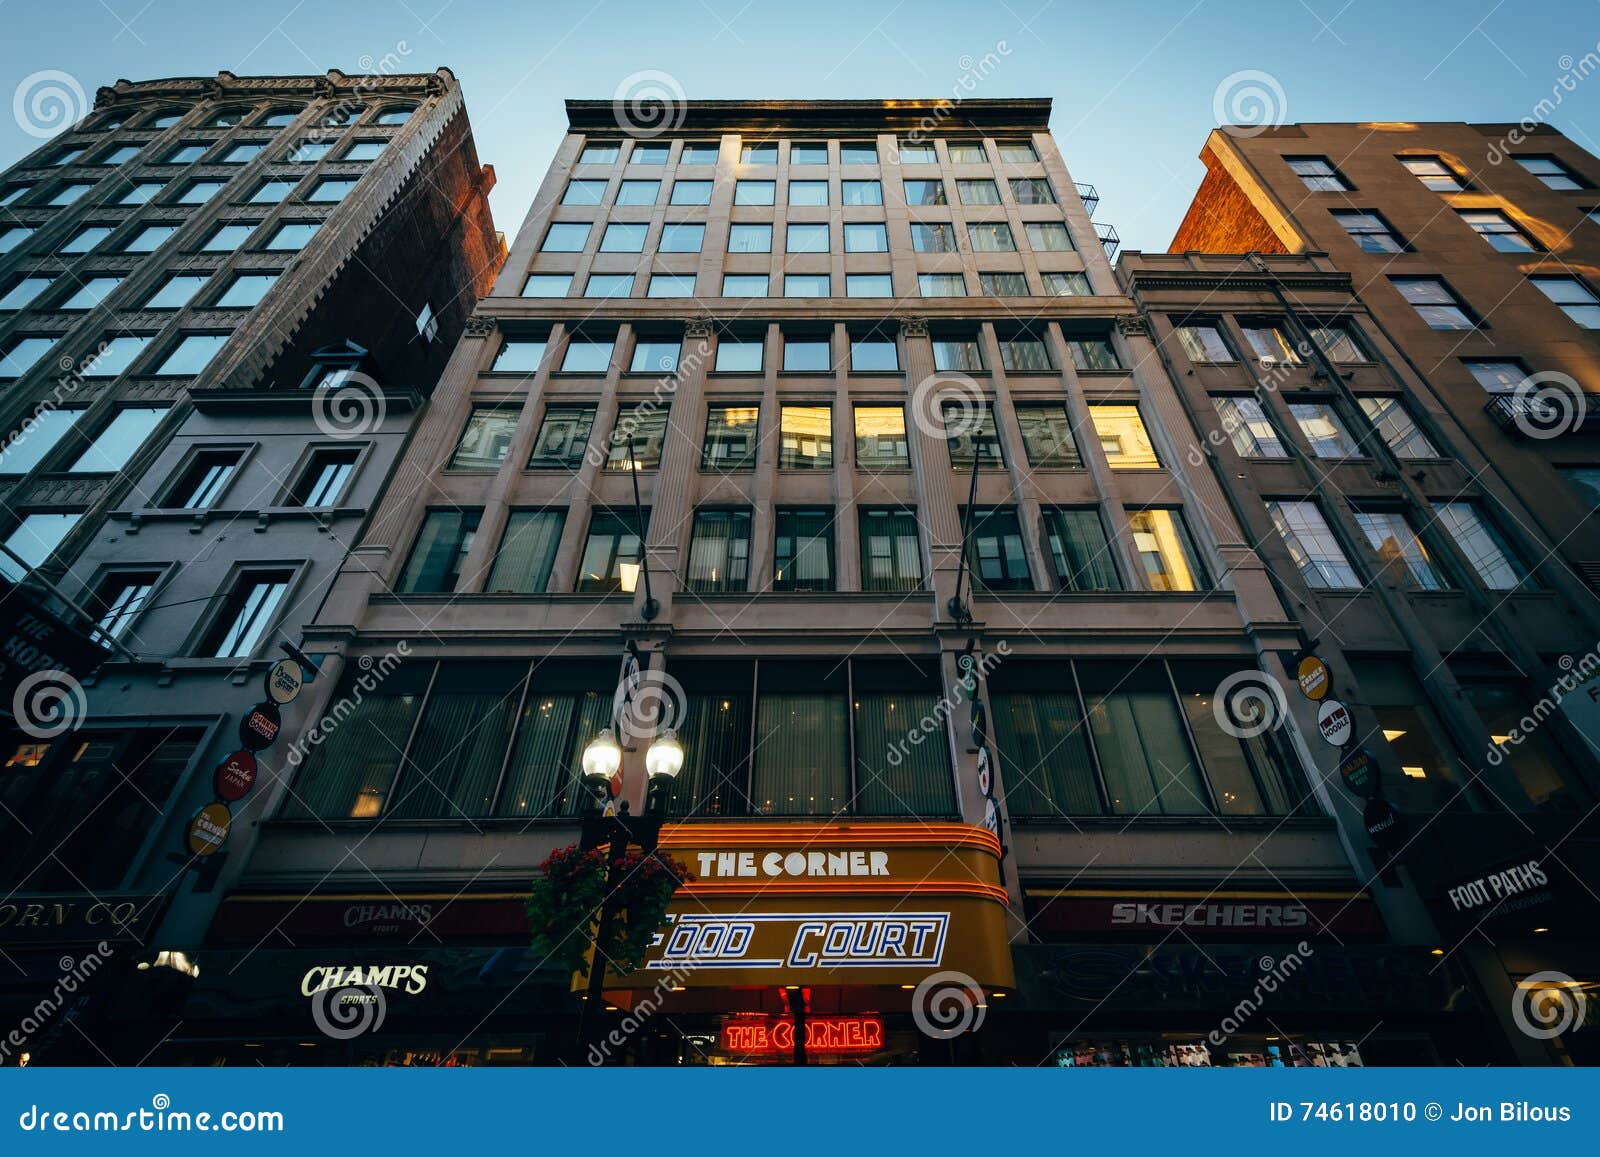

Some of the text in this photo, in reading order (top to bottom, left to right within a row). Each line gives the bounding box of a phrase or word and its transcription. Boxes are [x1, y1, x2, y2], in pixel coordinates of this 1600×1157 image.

[1323, 716, 1349, 738] NOODLE
[697, 851, 889, 877] THE CORNER
[1447, 878, 1492, 912] FOOT
[1487, 860, 1548, 899] PATHS
[343, 904, 433, 929] CHAMPS
[1111, 903, 1308, 927] SKECHERS
[787, 921, 937, 968] COURT
[301, 964, 429, 997] CHAMPS
[340, 994, 378, 1005] SPORTS
[727, 1026, 768, 1048] THE
